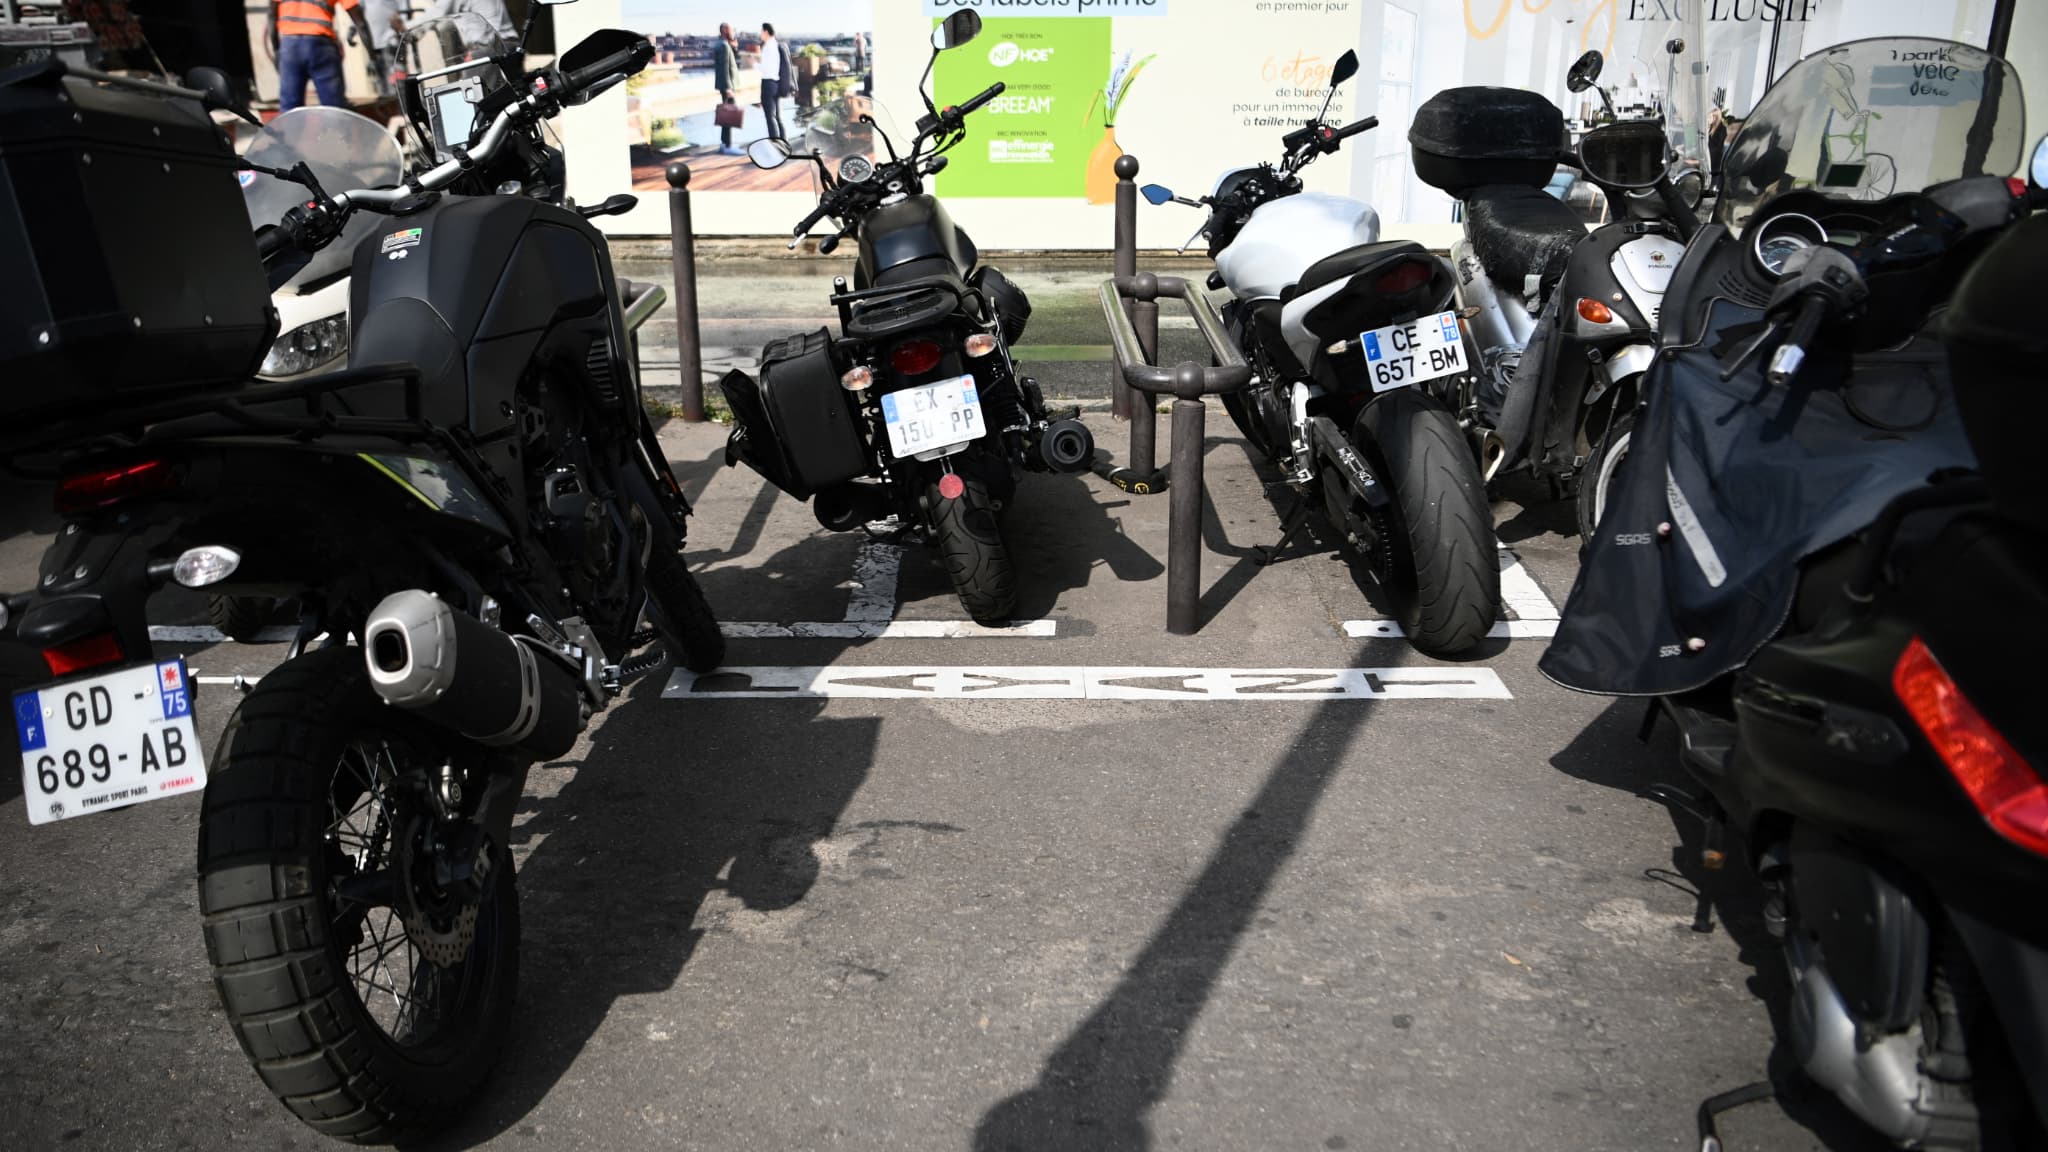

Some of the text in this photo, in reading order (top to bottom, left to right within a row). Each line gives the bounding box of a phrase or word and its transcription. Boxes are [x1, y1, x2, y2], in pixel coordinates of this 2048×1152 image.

[1256, 1, 1349, 13] en premier jour
[1276, 88, 1291, 97] de
[989, 96, 1051, 113] BREEAM
[1232, 104, 1260, 114] pour
[1263, 104, 1279, 112] un
[1243, 117, 1342, 127] à taille huine
[1392, 326, 1421, 352] CE
[1443, 328, 1458, 340] 78
[1375, 345, 1460, 385] 657-BM
[913, 388, 938, 413] EX
[689, 672, 1476, 693] PAYANT
[64, 685, 113, 731] GD
[164, 691, 187, 715] 75
[27, 727, 37, 742] F
[37, 726, 187, 794] 689-AB
[167, 777, 195, 788] YAMAHA
[110, 791, 129, 801] SPORT
[130, 786, 148, 797] PARIS
